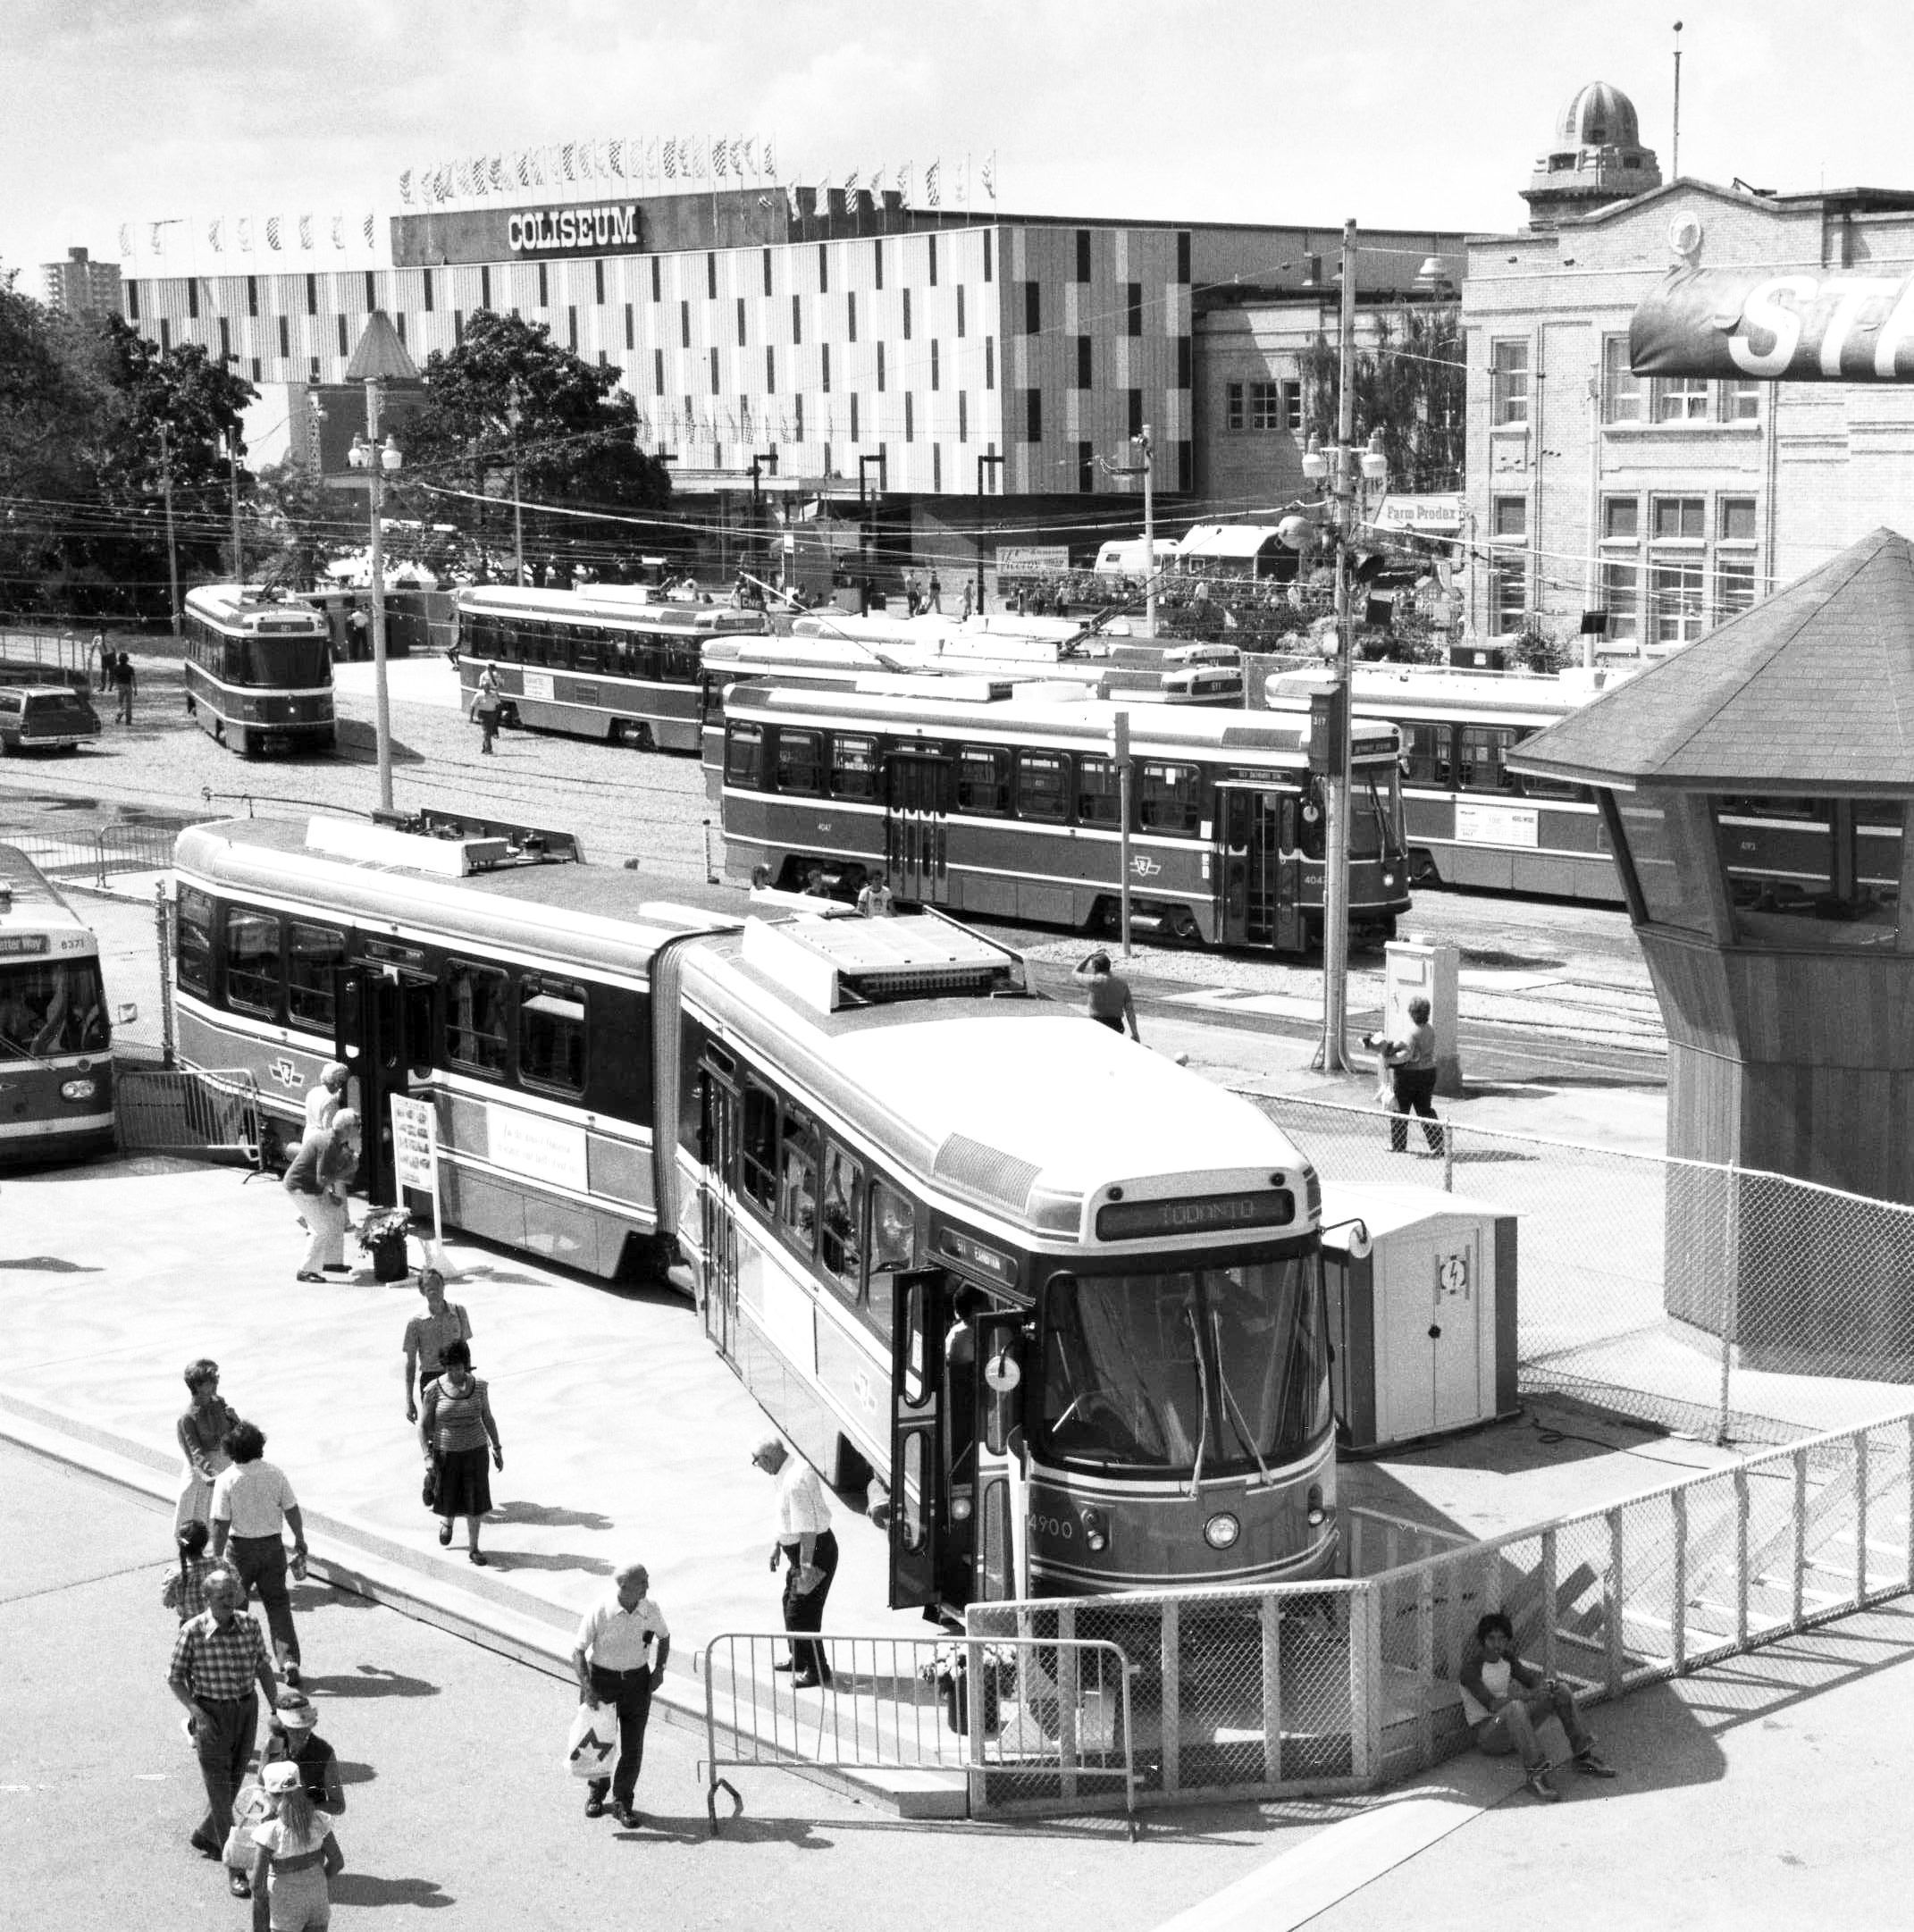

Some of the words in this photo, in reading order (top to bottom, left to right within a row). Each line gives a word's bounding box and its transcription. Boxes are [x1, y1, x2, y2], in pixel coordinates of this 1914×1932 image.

[508, 206, 637, 251] COLISEUM
[1388, 506, 1415, 519] Farm
[1417, 506, 1456, 520] Prodex
[1304, 875, 1329, 885] 404
[1027, 1514, 1072, 1539] 4900
